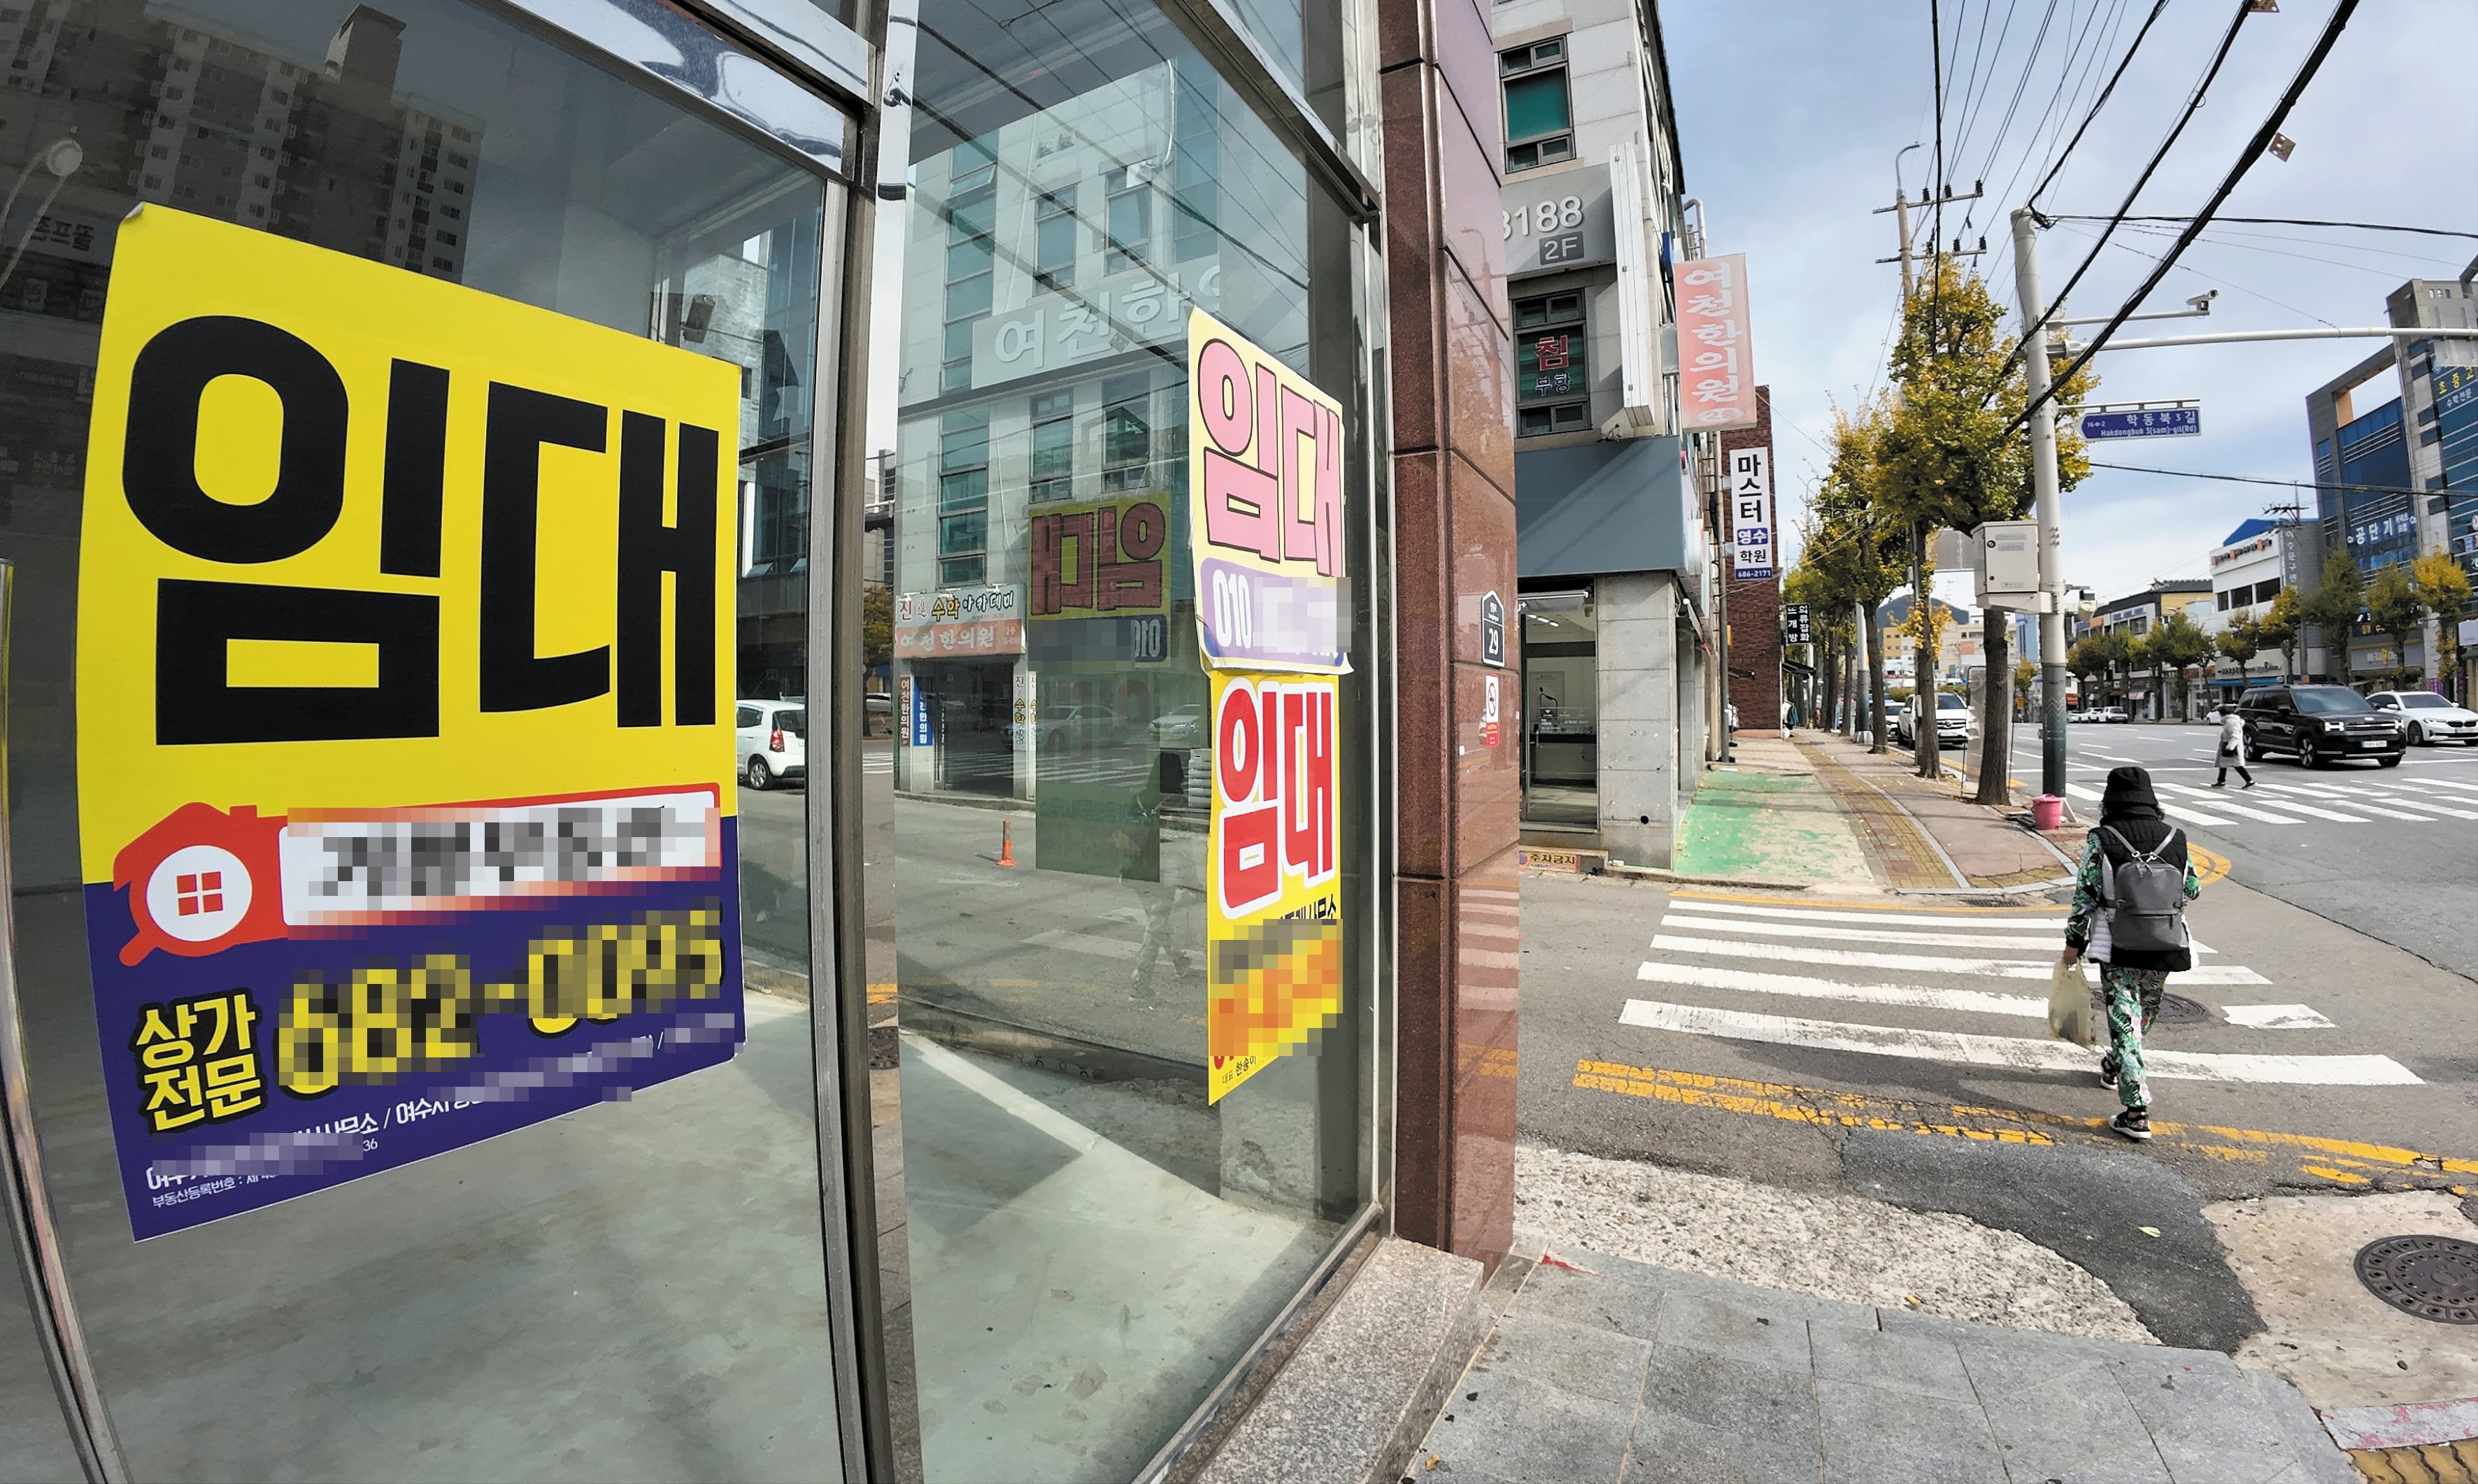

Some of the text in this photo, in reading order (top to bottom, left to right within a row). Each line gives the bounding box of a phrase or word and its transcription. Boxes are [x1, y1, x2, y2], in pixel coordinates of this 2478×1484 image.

[1544, 236, 1579, 261] 2F
[1684, 262, 1744, 403] 여천한의원
[1534, 334, 1569, 371] 침
[1535, 371, 1572, 397] 부항
[2101, 425, 2197, 437] Hakdongbuk 3(sam)-gil(Rd)
[1197, 338, 1344, 578] 임대
[1737, 454, 1762, 523] 마스터
[123, 316, 719, 745] 임대
[1738, 529, 1767, 545] 영수
[2356, 518, 2393, 545] 공단기
[1739, 549, 1767, 564] 학원
[1737, 569, 1772, 578] 686-2171
[932, 597, 961, 622] 수학
[962, 590, 1014, 613] 아카데미
[1787, 606, 1798, 643] 뜨개방
[900, 626, 995, 652] 여천한의원
[1488, 627, 1499, 655] 29
[1220, 688, 1333, 908] 임대
[1530, 853, 1576, 864] 주차금지
[136, 994, 256, 1069] 상가
[1222, 1069, 1234, 1084] 대표
[144, 1053, 262, 1131] 전문
